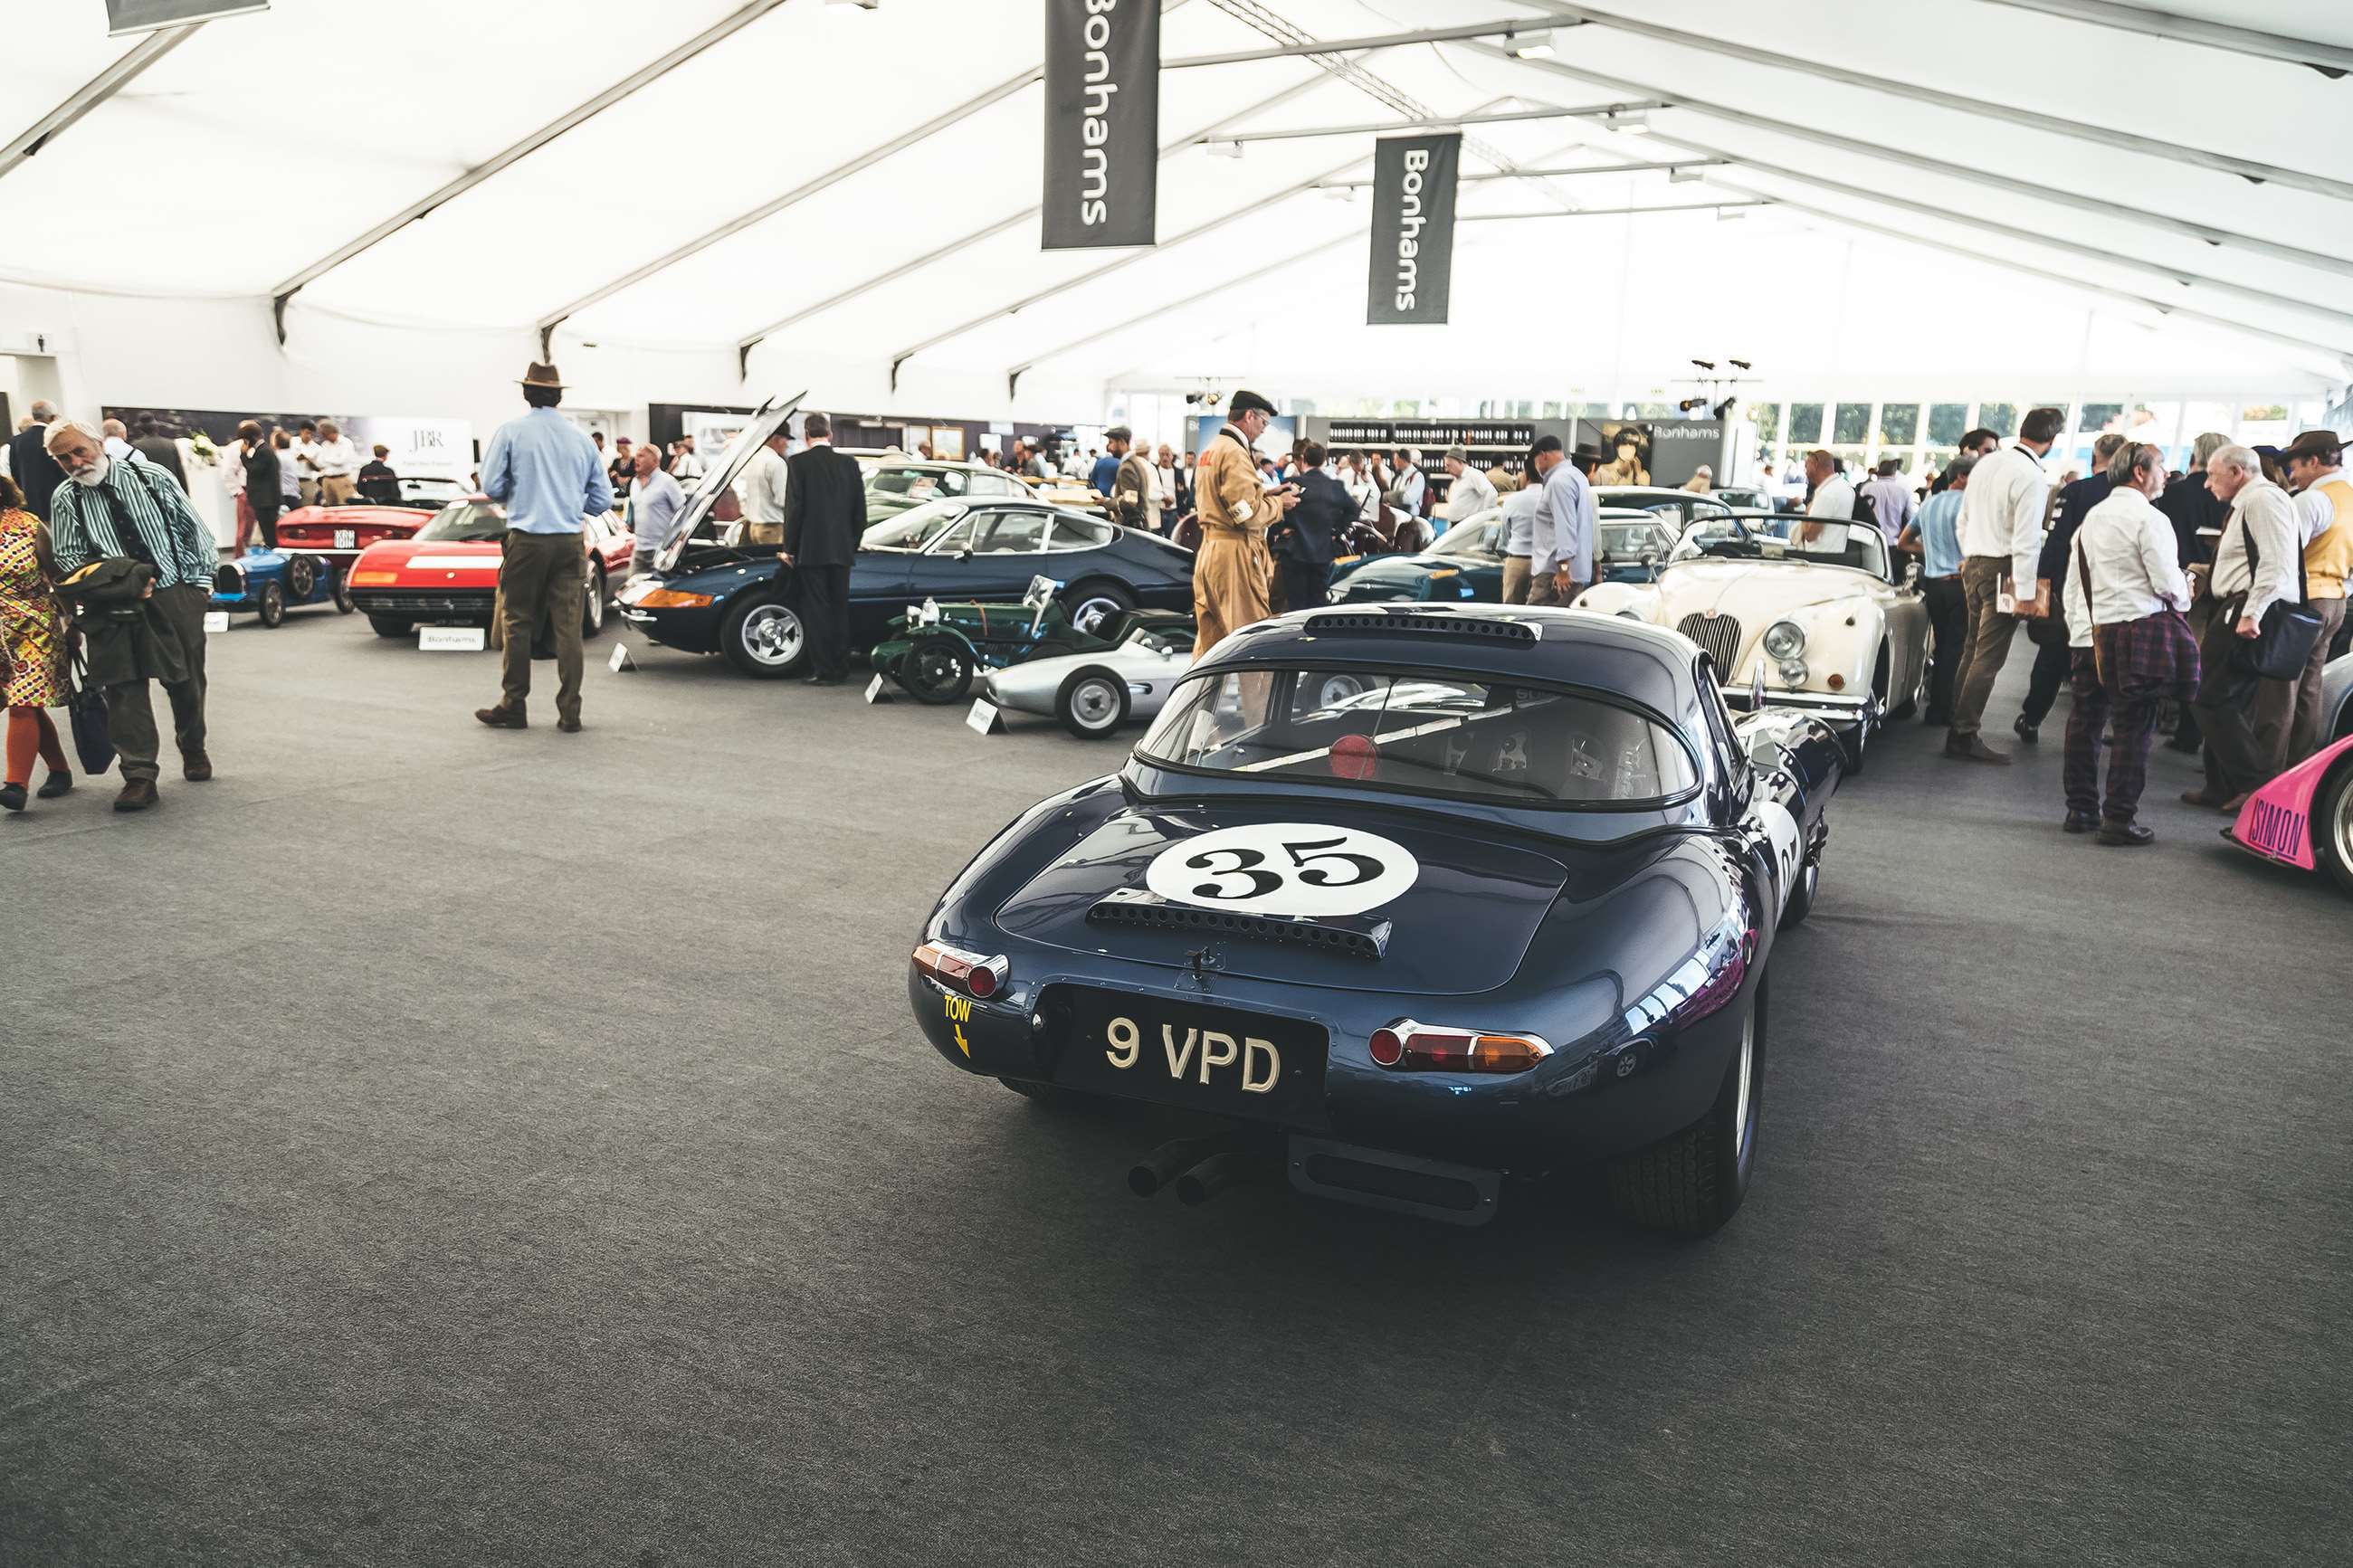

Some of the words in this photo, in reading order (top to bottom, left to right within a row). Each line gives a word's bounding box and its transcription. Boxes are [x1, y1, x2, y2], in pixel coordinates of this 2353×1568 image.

[1395, 149, 1429, 312] Bonhams
[2252, 799, 2306, 856] SIMON
[1186, 836, 1386, 899] 35
[944, 994, 972, 1023] TOW
[1106, 1017, 1140, 1069] 9
[1162, 1023, 1281, 1093] VPD
